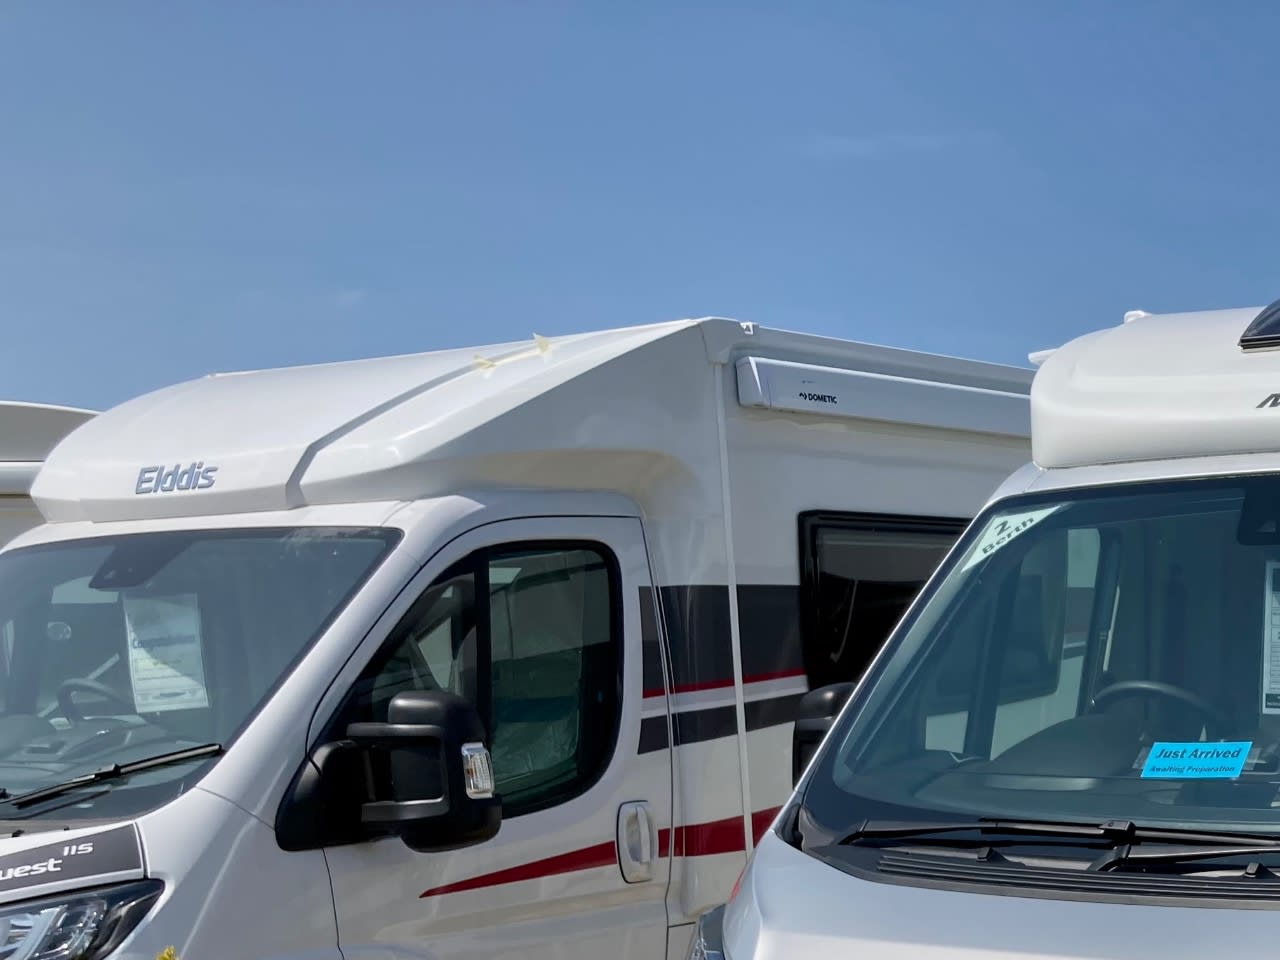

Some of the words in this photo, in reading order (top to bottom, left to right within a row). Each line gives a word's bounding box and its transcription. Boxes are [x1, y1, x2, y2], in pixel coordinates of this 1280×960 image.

[808, 392, 838, 405] DOMETIC
[135, 461, 219, 495] Elddis
[994, 520, 1011, 536] 2
[982, 517, 1034, 554] Berth
[1156, 748, 1187, 758] Just
[1188, 748, 1242, 758] Arrived
[1149, 766, 1185, 774] Awaiting
[1186, 766, 1235, 774] Preparation
